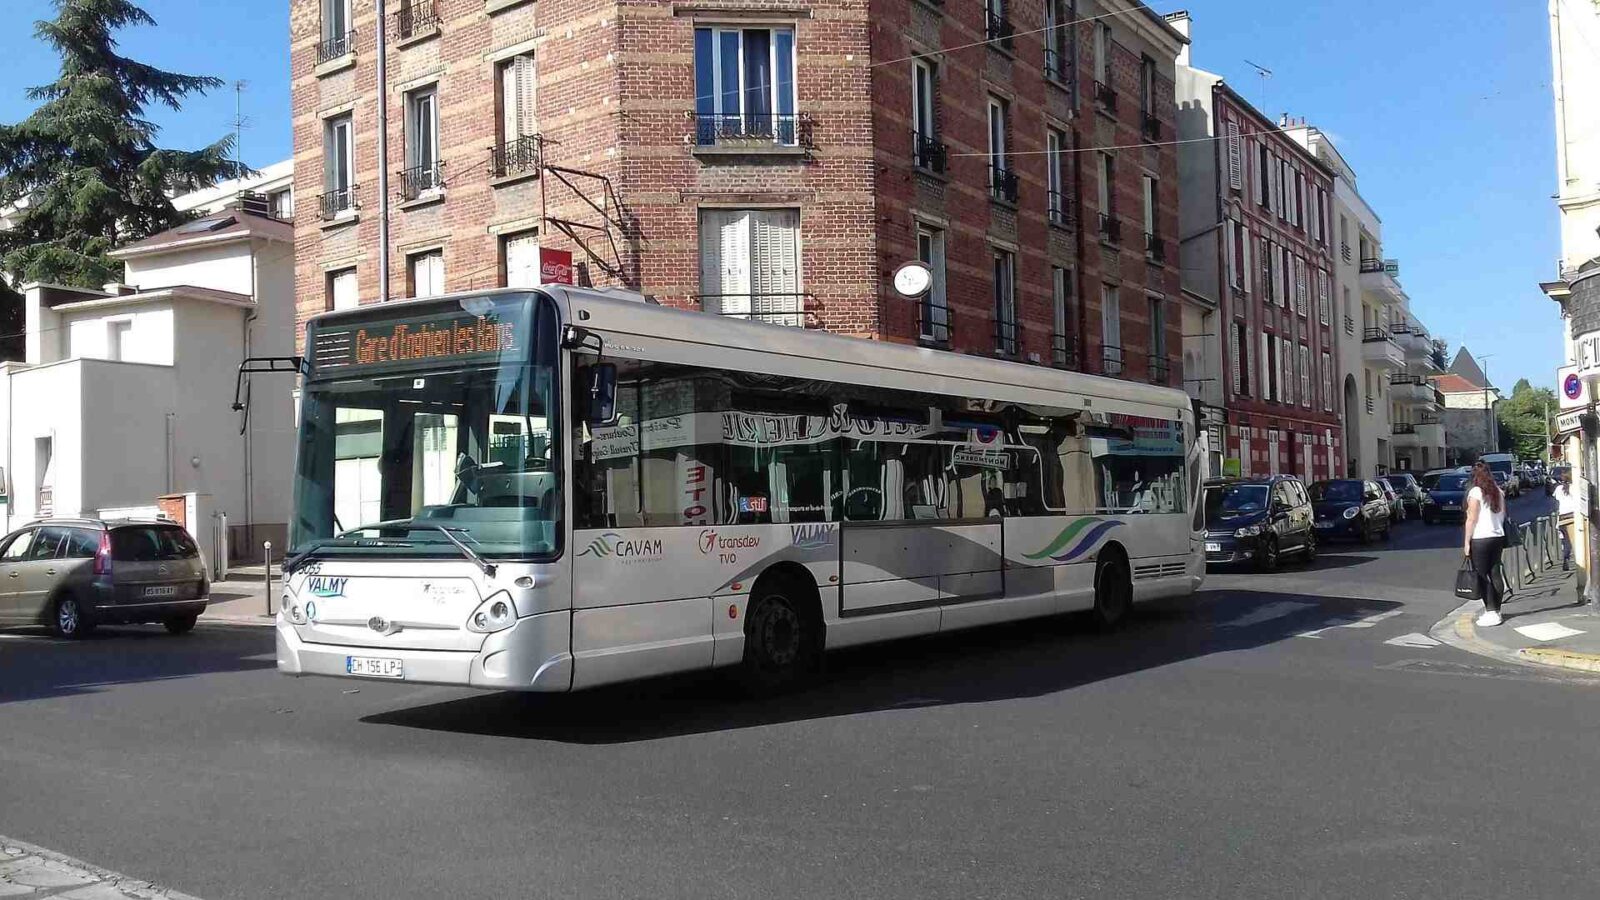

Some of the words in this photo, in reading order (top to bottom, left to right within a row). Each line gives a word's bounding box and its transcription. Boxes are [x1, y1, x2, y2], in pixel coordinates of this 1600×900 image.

[355, 328, 388, 365] Gare
[453, 319, 475, 355] les
[1559, 415, 1581, 428] MONT
[718, 535, 760, 549] transdev
[790, 523, 834, 546] VALMY
[615, 539, 663, 557] CAVAM
[719, 553, 737, 564] TVO
[308, 577, 349, 596] VALMY
[352, 658, 363, 672] CH
[384, 661, 396, 674] LP
